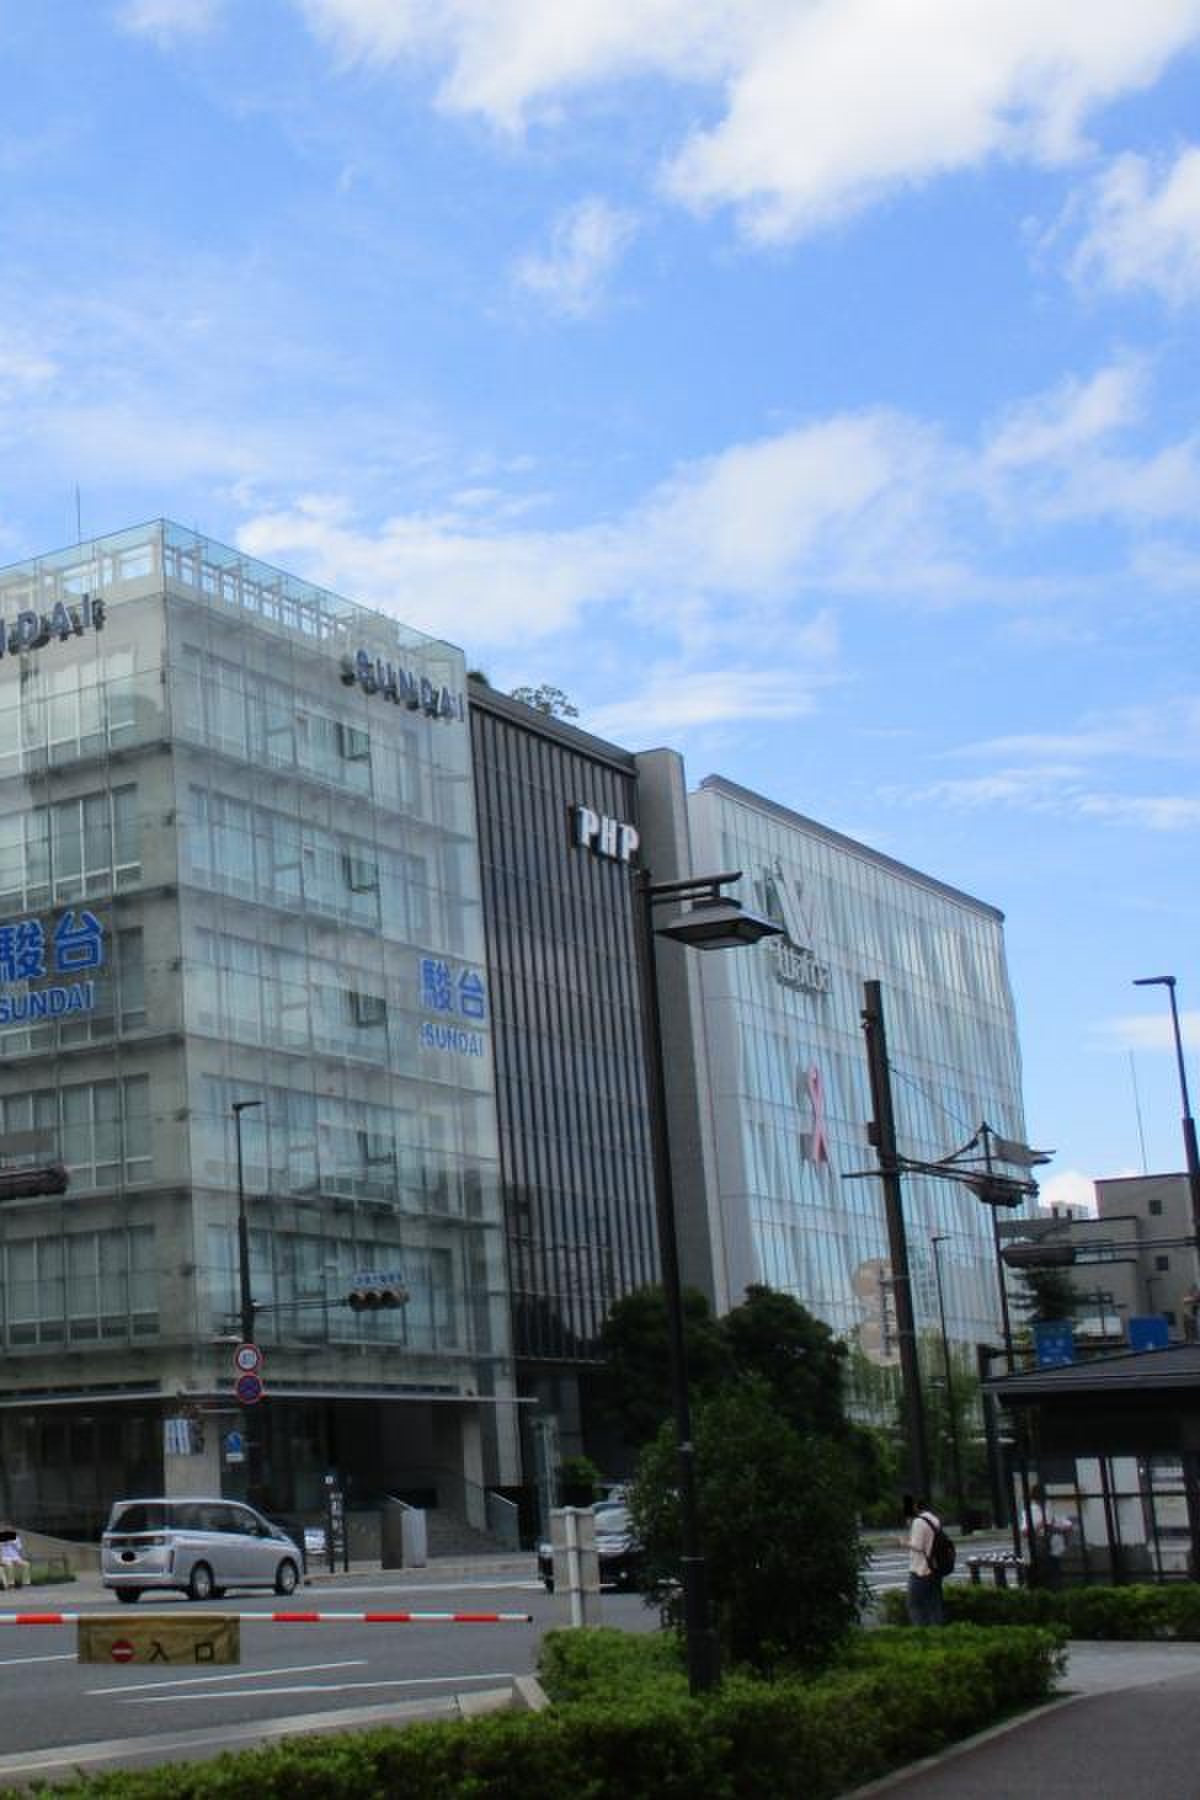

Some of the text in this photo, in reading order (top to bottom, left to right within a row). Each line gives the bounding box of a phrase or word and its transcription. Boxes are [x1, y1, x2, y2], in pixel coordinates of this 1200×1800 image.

[355, 649, 464, 722] SUNDAI
[577, 806, 639, 862] PHP
[420, 958, 485, 1020] 駿台
[419, 1023, 484, 1057] SUNDAI
[149, 1640, 215, 1664] 入口
